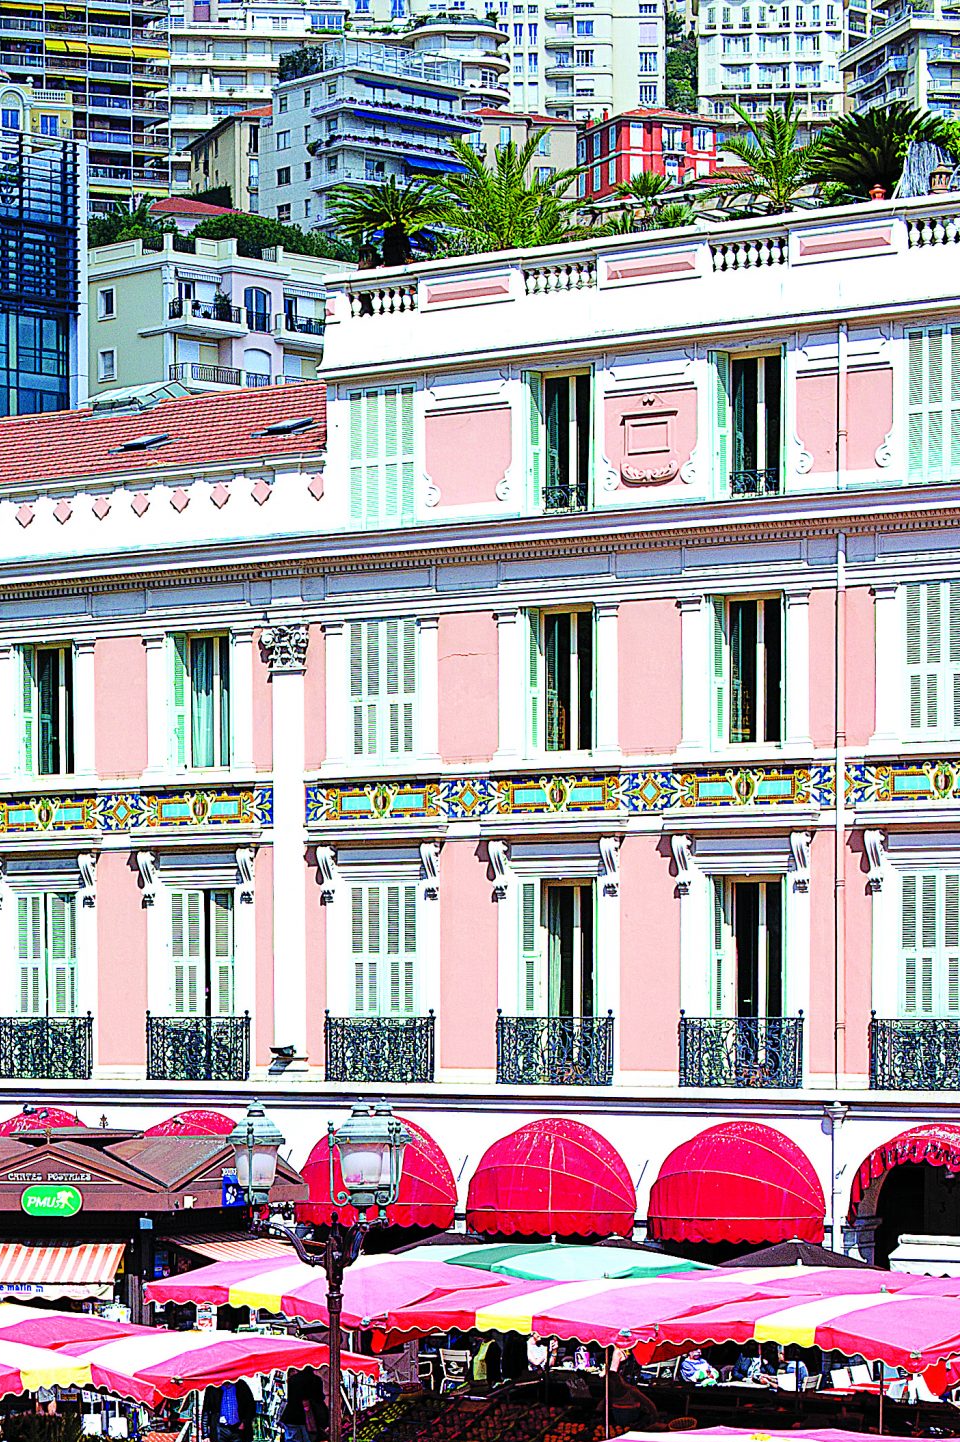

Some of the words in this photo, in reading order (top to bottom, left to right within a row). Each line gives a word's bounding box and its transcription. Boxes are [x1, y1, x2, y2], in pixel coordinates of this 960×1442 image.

[7, 1172, 42, 1181] CARTES
[47, 1172, 91, 1181] POSTALES
[26, 1195, 56, 1208] PMU
[6, 1283, 32, 1292] matin
